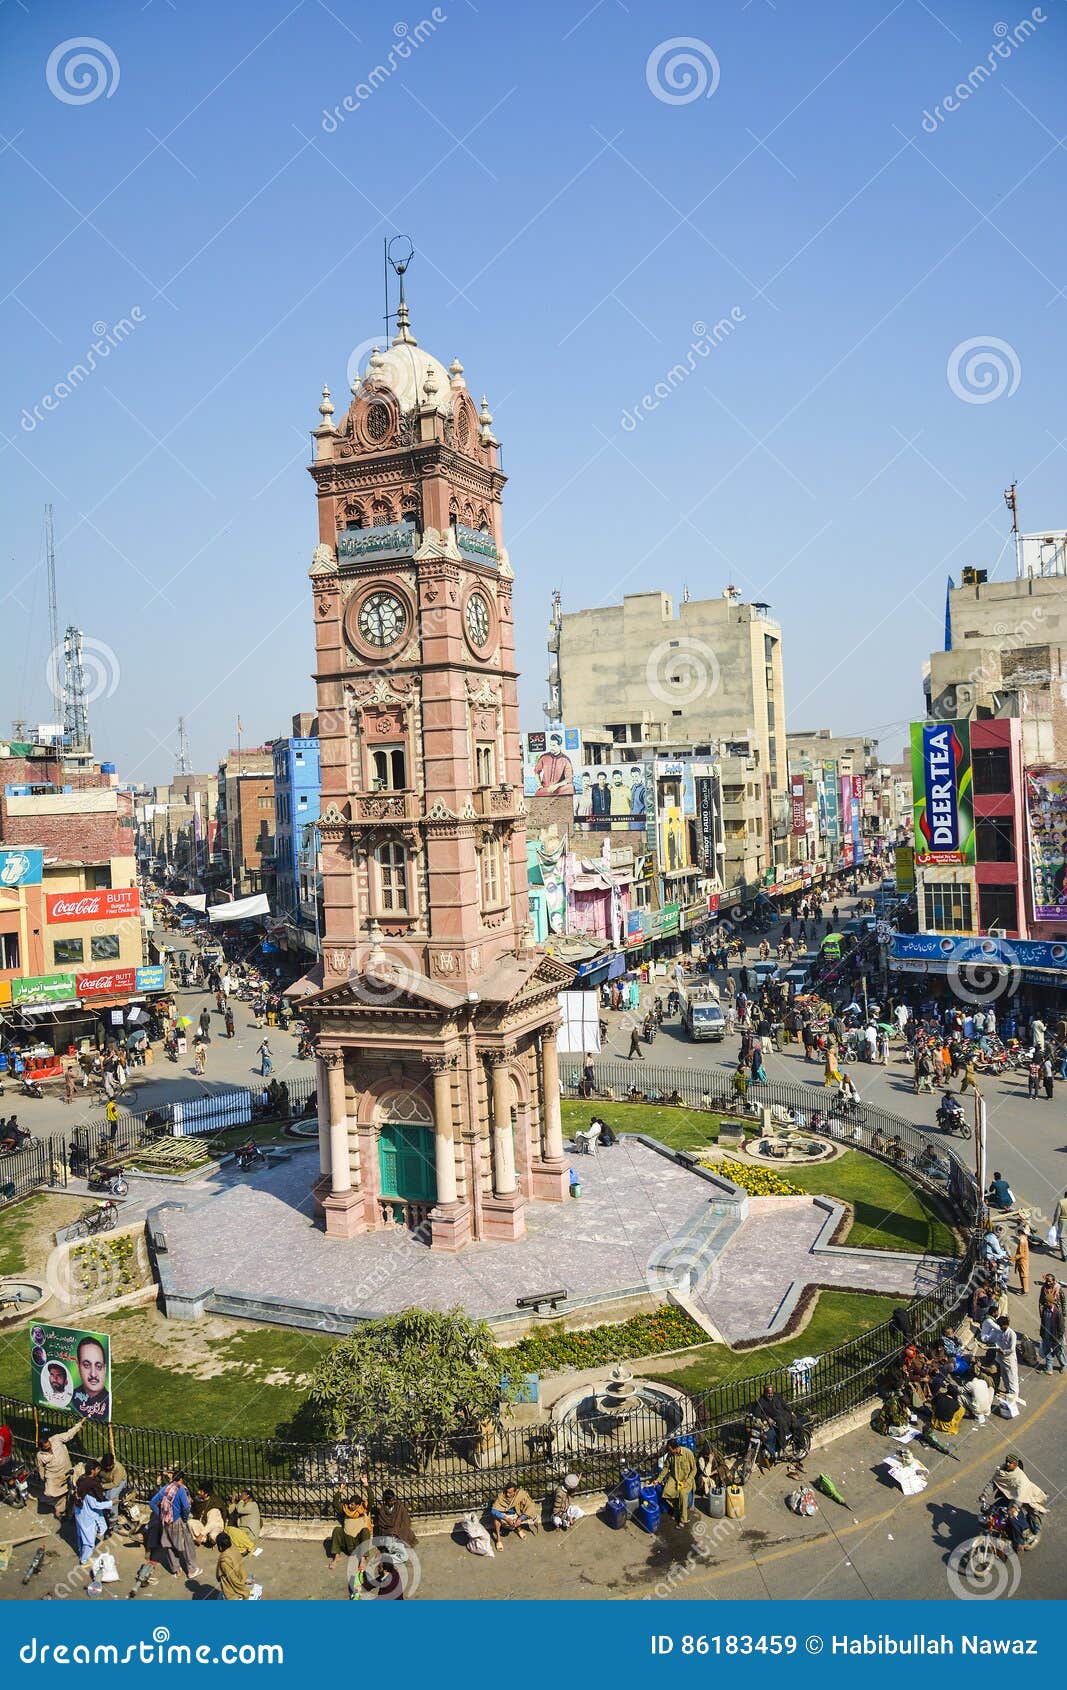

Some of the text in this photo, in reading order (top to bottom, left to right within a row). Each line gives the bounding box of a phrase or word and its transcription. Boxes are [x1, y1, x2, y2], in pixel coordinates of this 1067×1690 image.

[929, 730, 953, 844] DEER TEA
[793, 800, 801, 828] CHIEF
[107, 892, 132, 903] BUTT
[52, 897, 101, 917] Coca-Cola
[79, 976, 113, 990] Coca-Cola
[115, 973, 132, 981] BUTT
